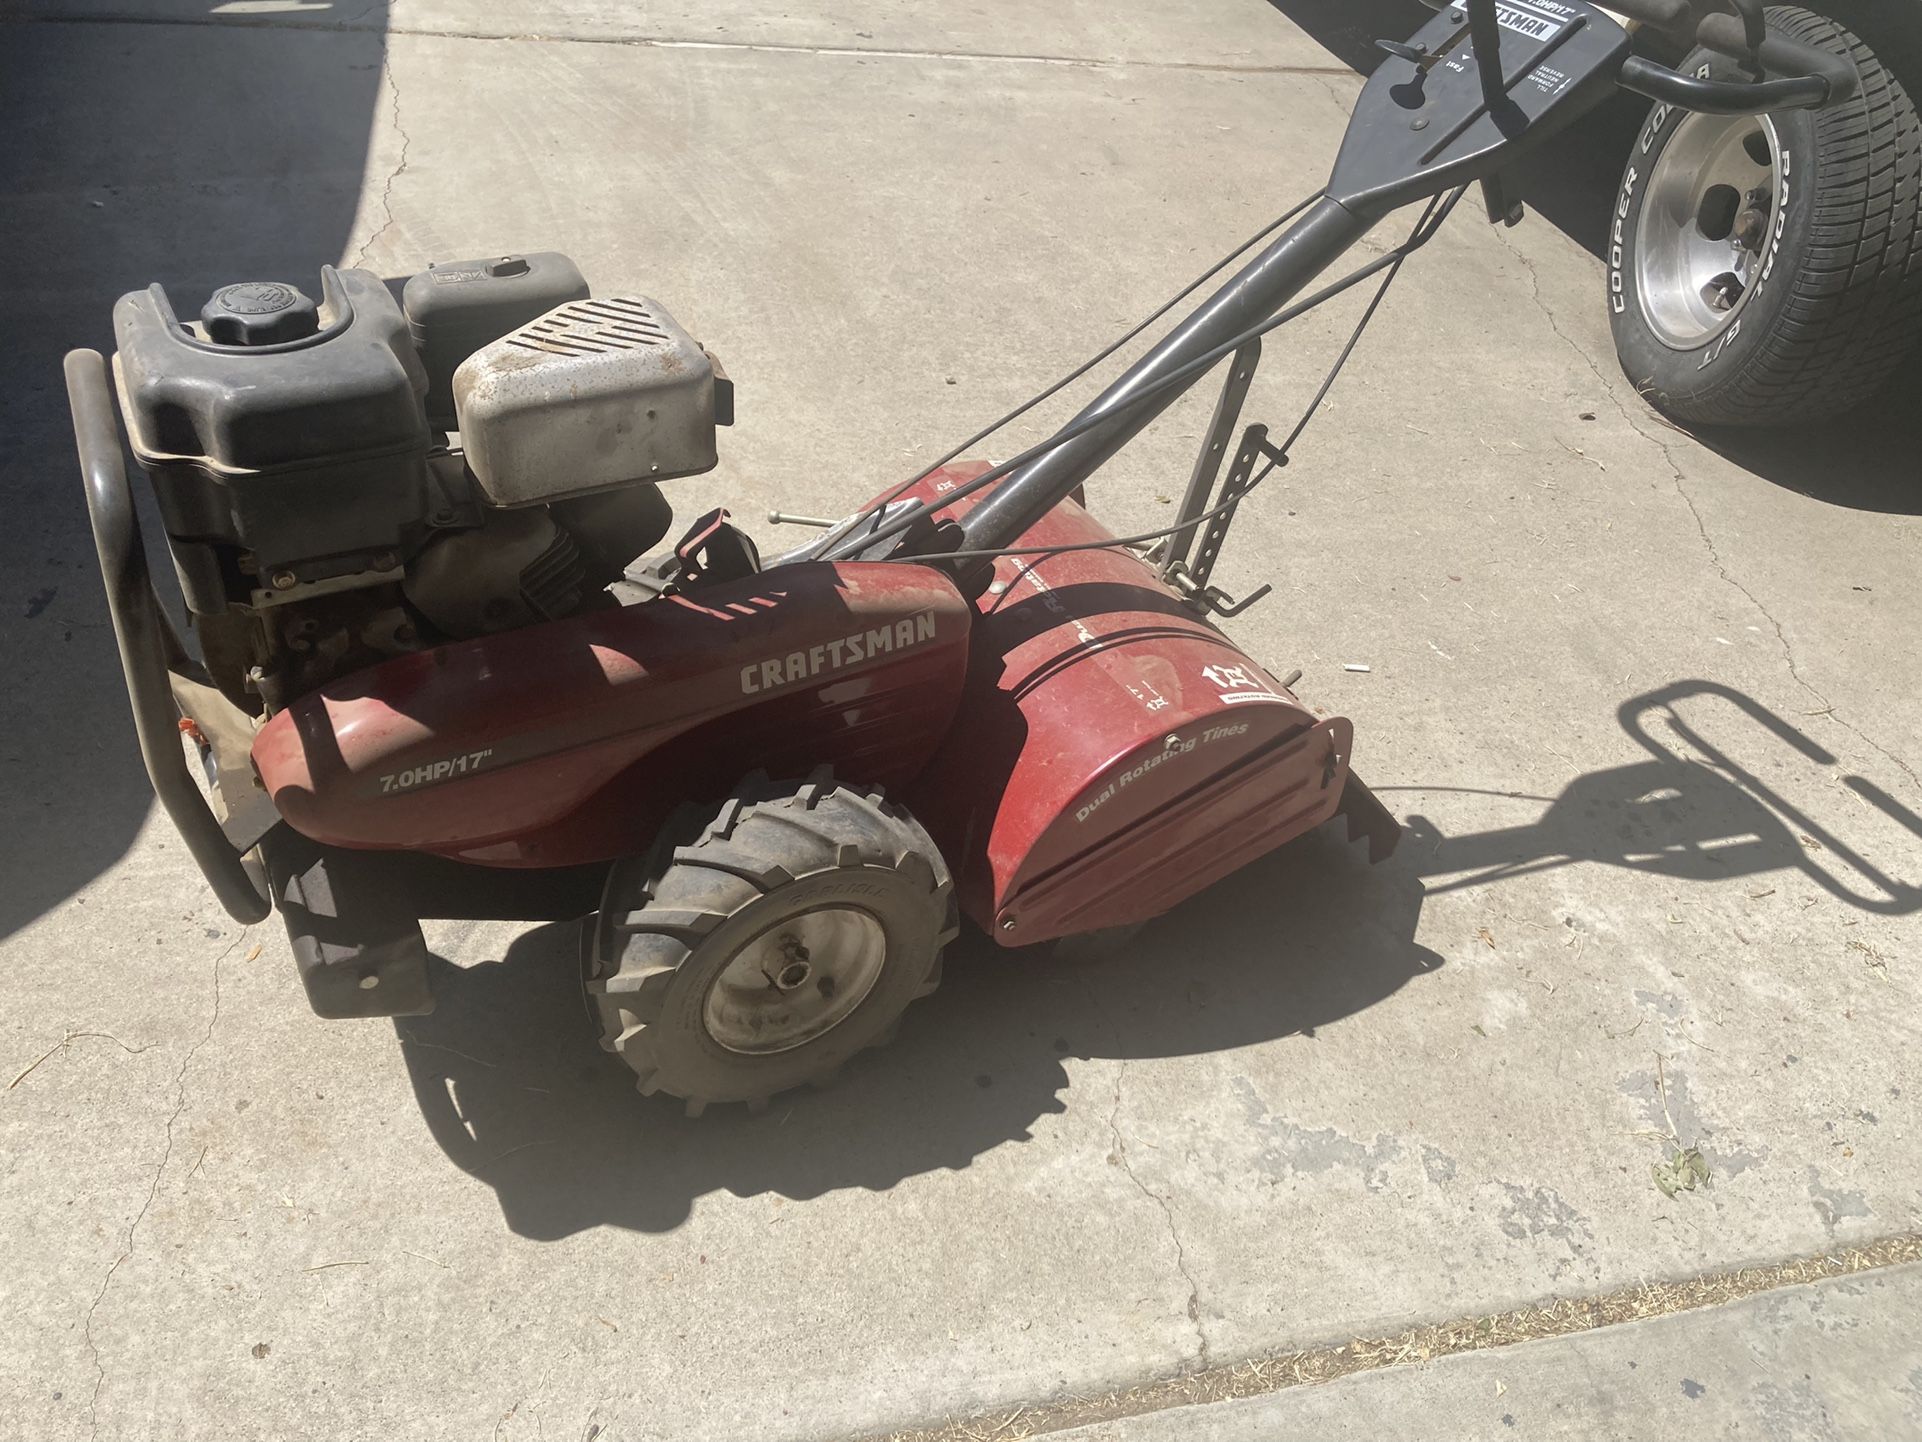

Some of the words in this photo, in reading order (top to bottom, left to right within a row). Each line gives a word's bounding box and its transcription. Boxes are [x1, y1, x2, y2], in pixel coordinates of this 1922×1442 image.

[1446, 60, 1464, 73] Fast
[1527, 74, 1554, 87] FORWARD
[1534, 69, 1560, 83] NEUTRAL
[1536, 84, 1549, 92] TILL
[1539, 65, 1565, 78] REVERSE
[1612, 166, 1638, 314] COOPER
[1641, 63, 1710, 154] COA
[1750, 150, 1790, 302] RADIAL
[1697, 319, 1742, 371] G/T
[740, 611, 936, 694] CRAFTSMAN
[380, 749, 493, 793] 7.0HP/17"
[1076, 783, 1116, 823] Dual
[1203, 723, 1249, 743] Tines
